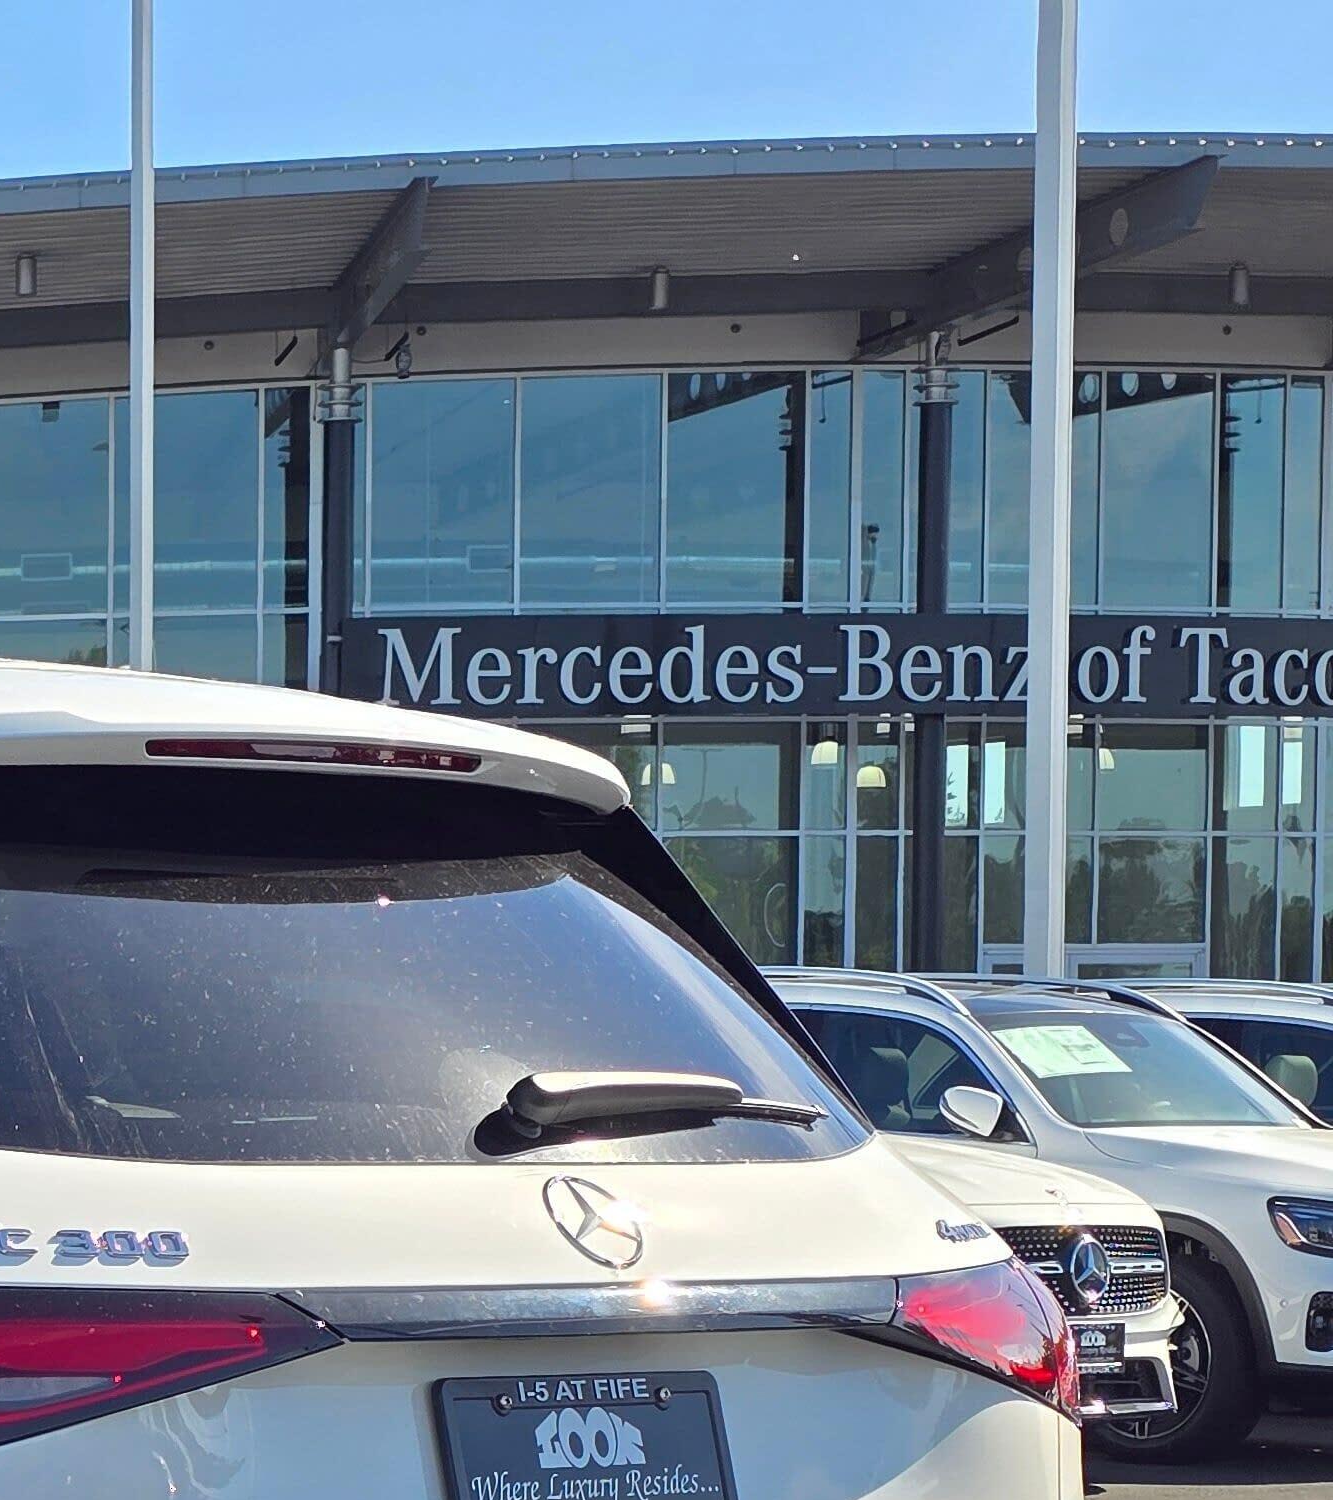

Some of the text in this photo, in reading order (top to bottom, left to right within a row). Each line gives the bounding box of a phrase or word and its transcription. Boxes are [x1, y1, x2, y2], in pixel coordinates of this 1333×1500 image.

[377, 624, 1029, 706] Mercedes-Benz
[1077, 624, 1156, 703] of
[52, 1228, 191, 1260] 300
[517, 1377, 650, 1402] I-5 AT FIFE
[534, 1406, 647, 1469] LOOK
